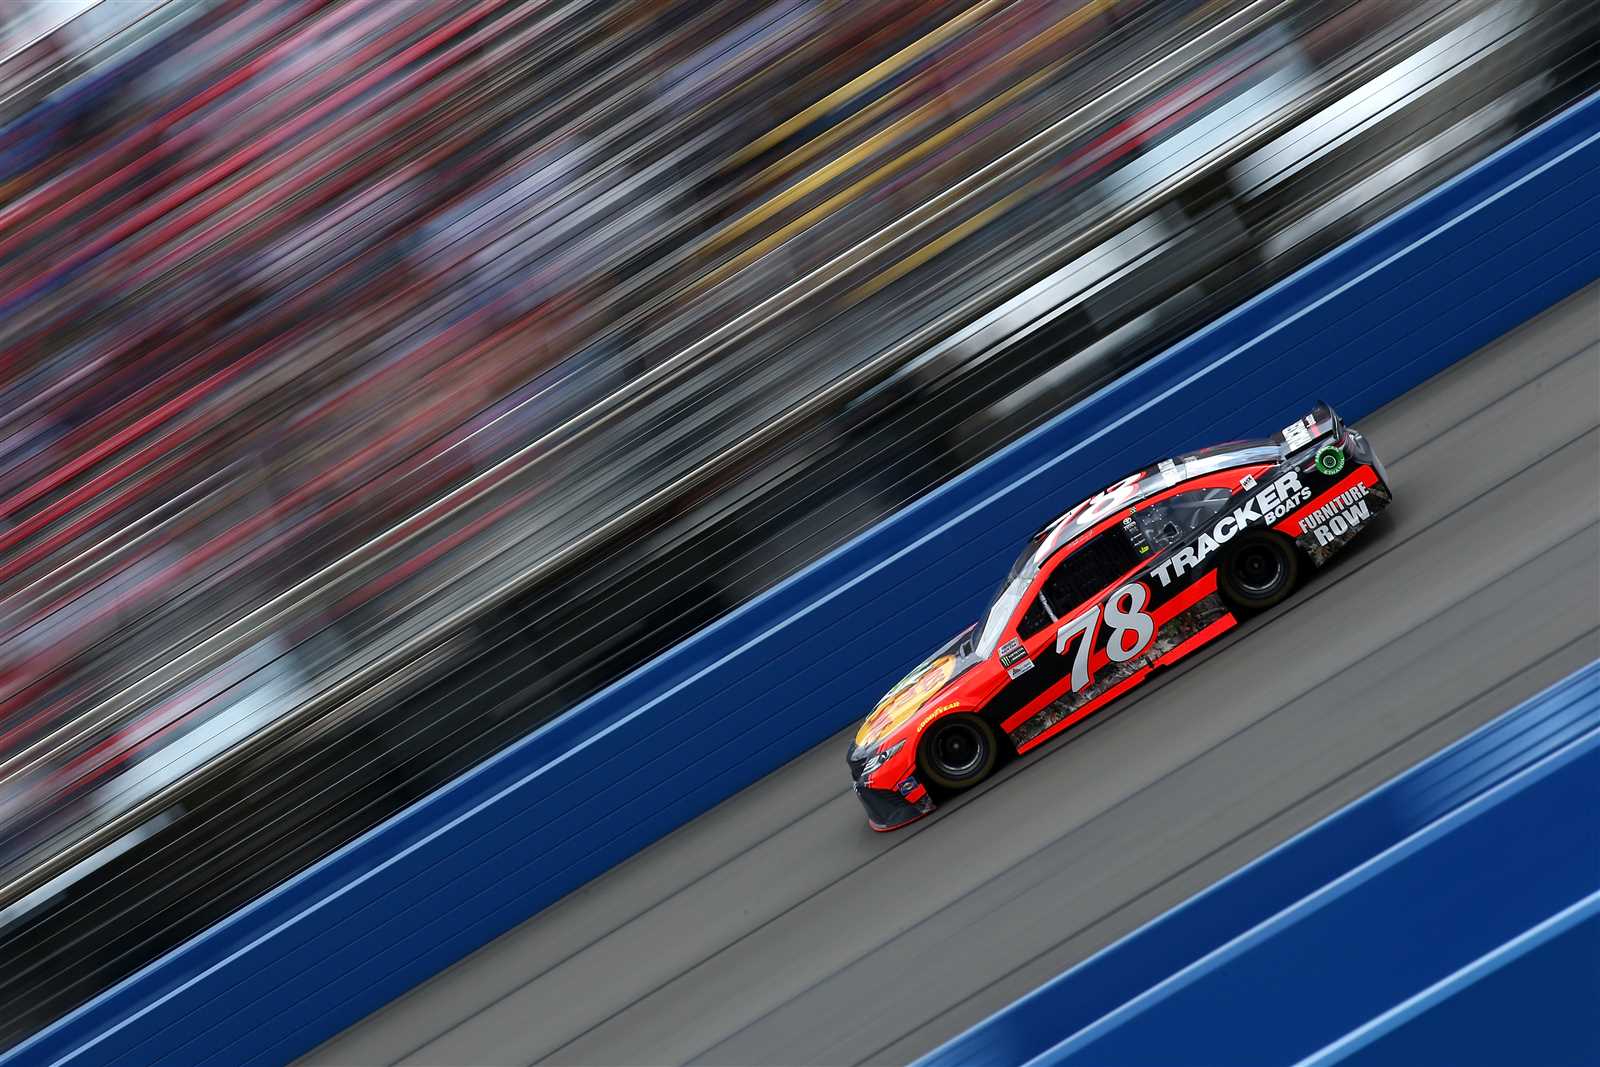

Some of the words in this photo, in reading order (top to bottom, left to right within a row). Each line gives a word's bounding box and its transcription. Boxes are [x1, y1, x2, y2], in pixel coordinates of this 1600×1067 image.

[1033, 472, 1143, 563] 78
[1151, 470, 1302, 587] TRACKER
[1264, 486, 1312, 525] BOATS
[1298, 482, 1369, 534] FURNITURE
[1314, 500, 1370, 546] ROW
[1056, 582, 1155, 693] 78
